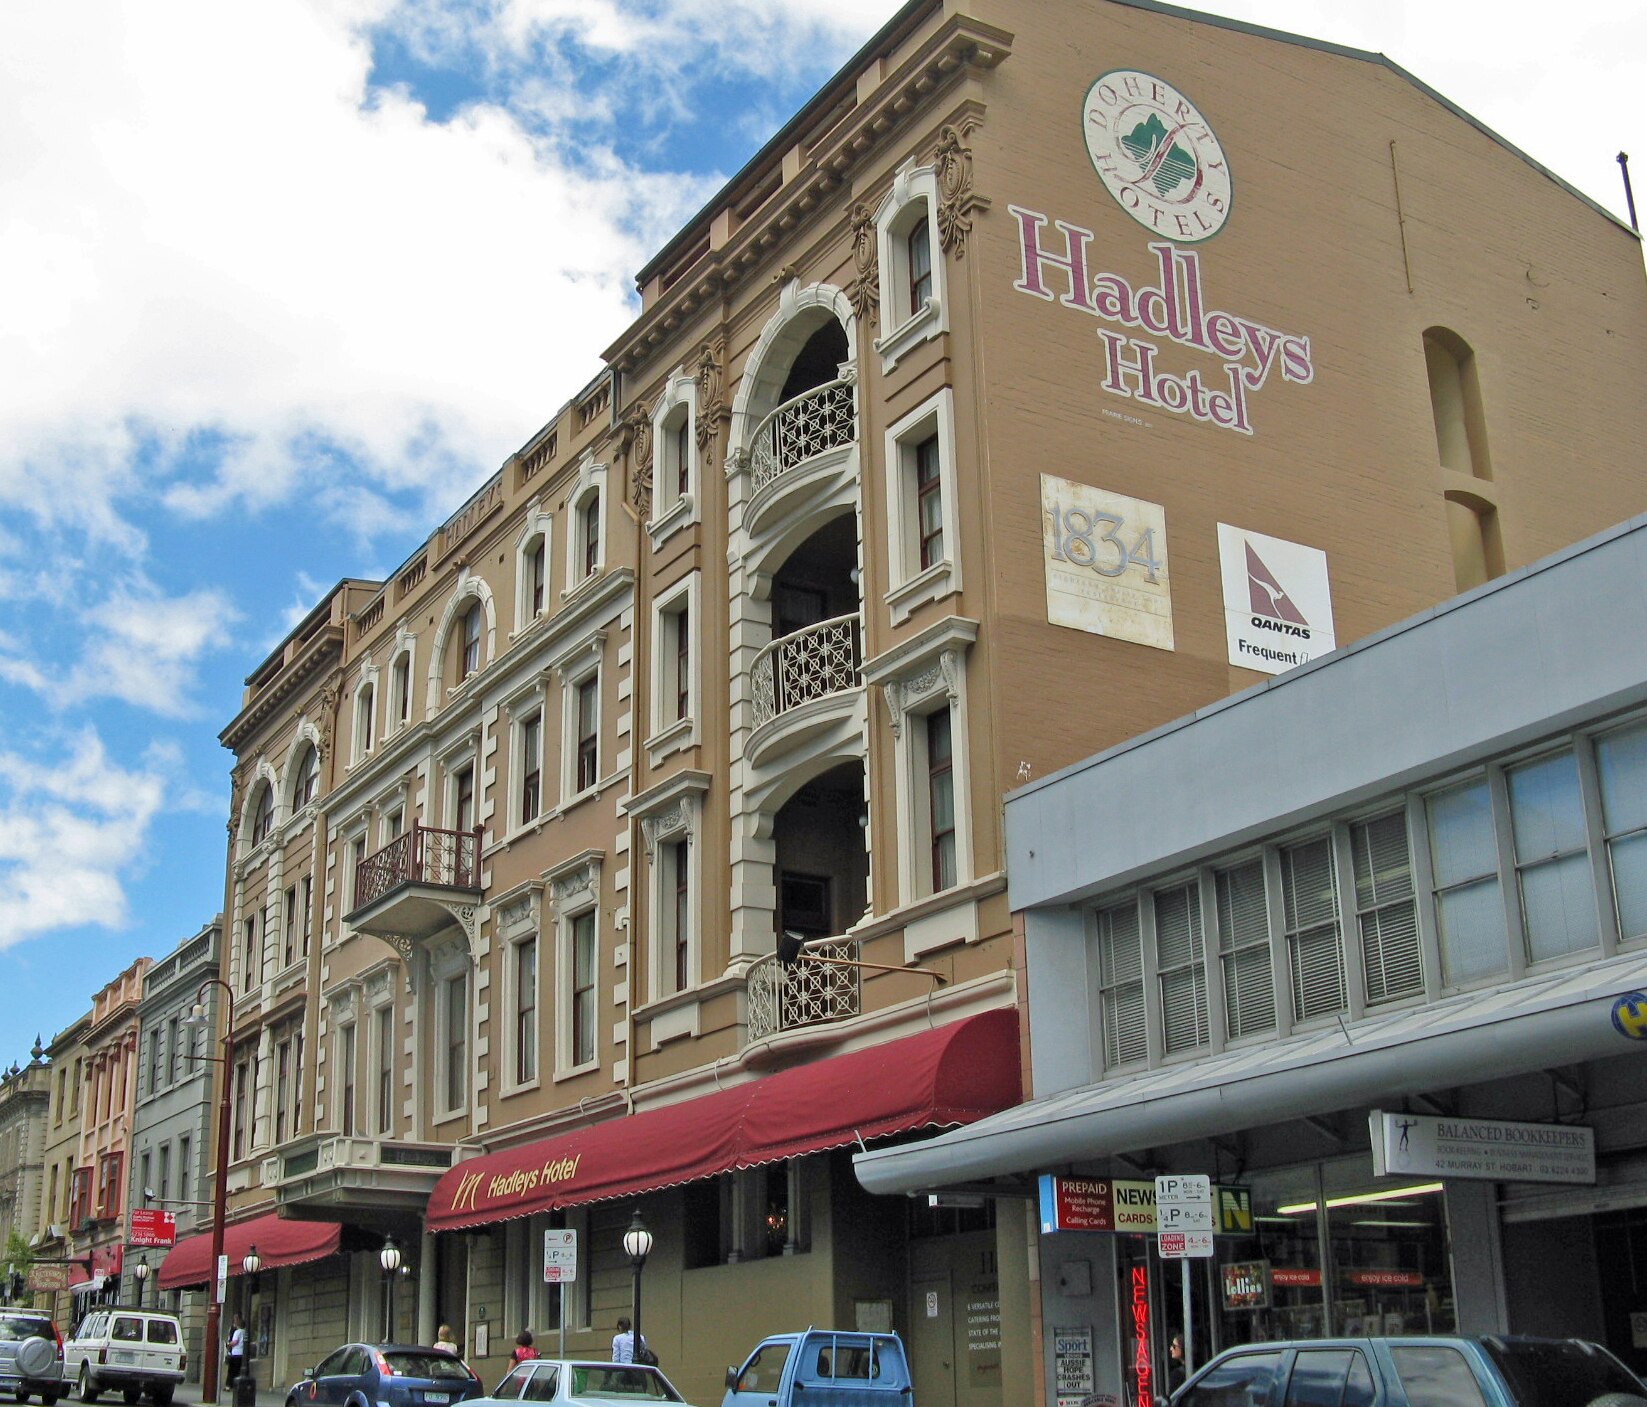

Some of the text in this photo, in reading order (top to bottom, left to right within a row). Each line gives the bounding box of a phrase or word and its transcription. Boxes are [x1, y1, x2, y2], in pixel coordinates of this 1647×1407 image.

[1088, 76, 1226, 178] DOHERTY
[1095, 152, 1225, 238] HOTELS
[1007, 204, 1314, 390] Hadleys
[1097, 328, 1253, 435] Hotel
[1046, 502, 1163, 585] 1834
[1251, 616, 1311, 640] QANTAS
[1238, 638, 1298, 665] Frequent
[1437, 1123, 1586, 1147] BALANCED BOOKKEEPERS
[1435, 1161, 1444, 1169] 42
[1447, 1162, 1483, 1171] MURRAY
[1486, 1163, 1495, 1171] ST
[1500, 1164, 1533, 1173] HOBART
[487, 1168, 540, 1199] Hadleys
[540, 1153, 581, 1186] Hotel
[1062, 1181, 1107, 1195] PREPAID
[1160, 1180, 1178, 1193] 1P
[1064, 1197, 1106, 1206] Mobile Phone
[1072, 1205, 1101, 1215] Recharge
[1222, 1191, 1250, 1230] N
[1066, 1216, 1107, 1226] Calling Cards
[1118, 1212, 1153, 1224] CARDS
[130, 1236, 153, 1245] Knight
[1161, 1234, 1184, 1242] LOADING
[1162, 1242, 1185, 1251] ZONE
[1274, 1274, 1289, 1282] enjoy
[1361, 1272, 1409, 1284] enjoy ice cold
[1225, 1277, 1263, 1296] lollies
[968, 1315, 990, 1324] CATERING
[982, 1328, 989, 1336] OF
[1058, 1338, 1088, 1354] Sport
[1060, 1359, 1086, 1367] AUSSIE
[1063, 1366, 1083, 1374] HOPE
[1056, 1373, 1091, 1381] CRASHES
[1066, 1381, 1081, 1389] OUT
